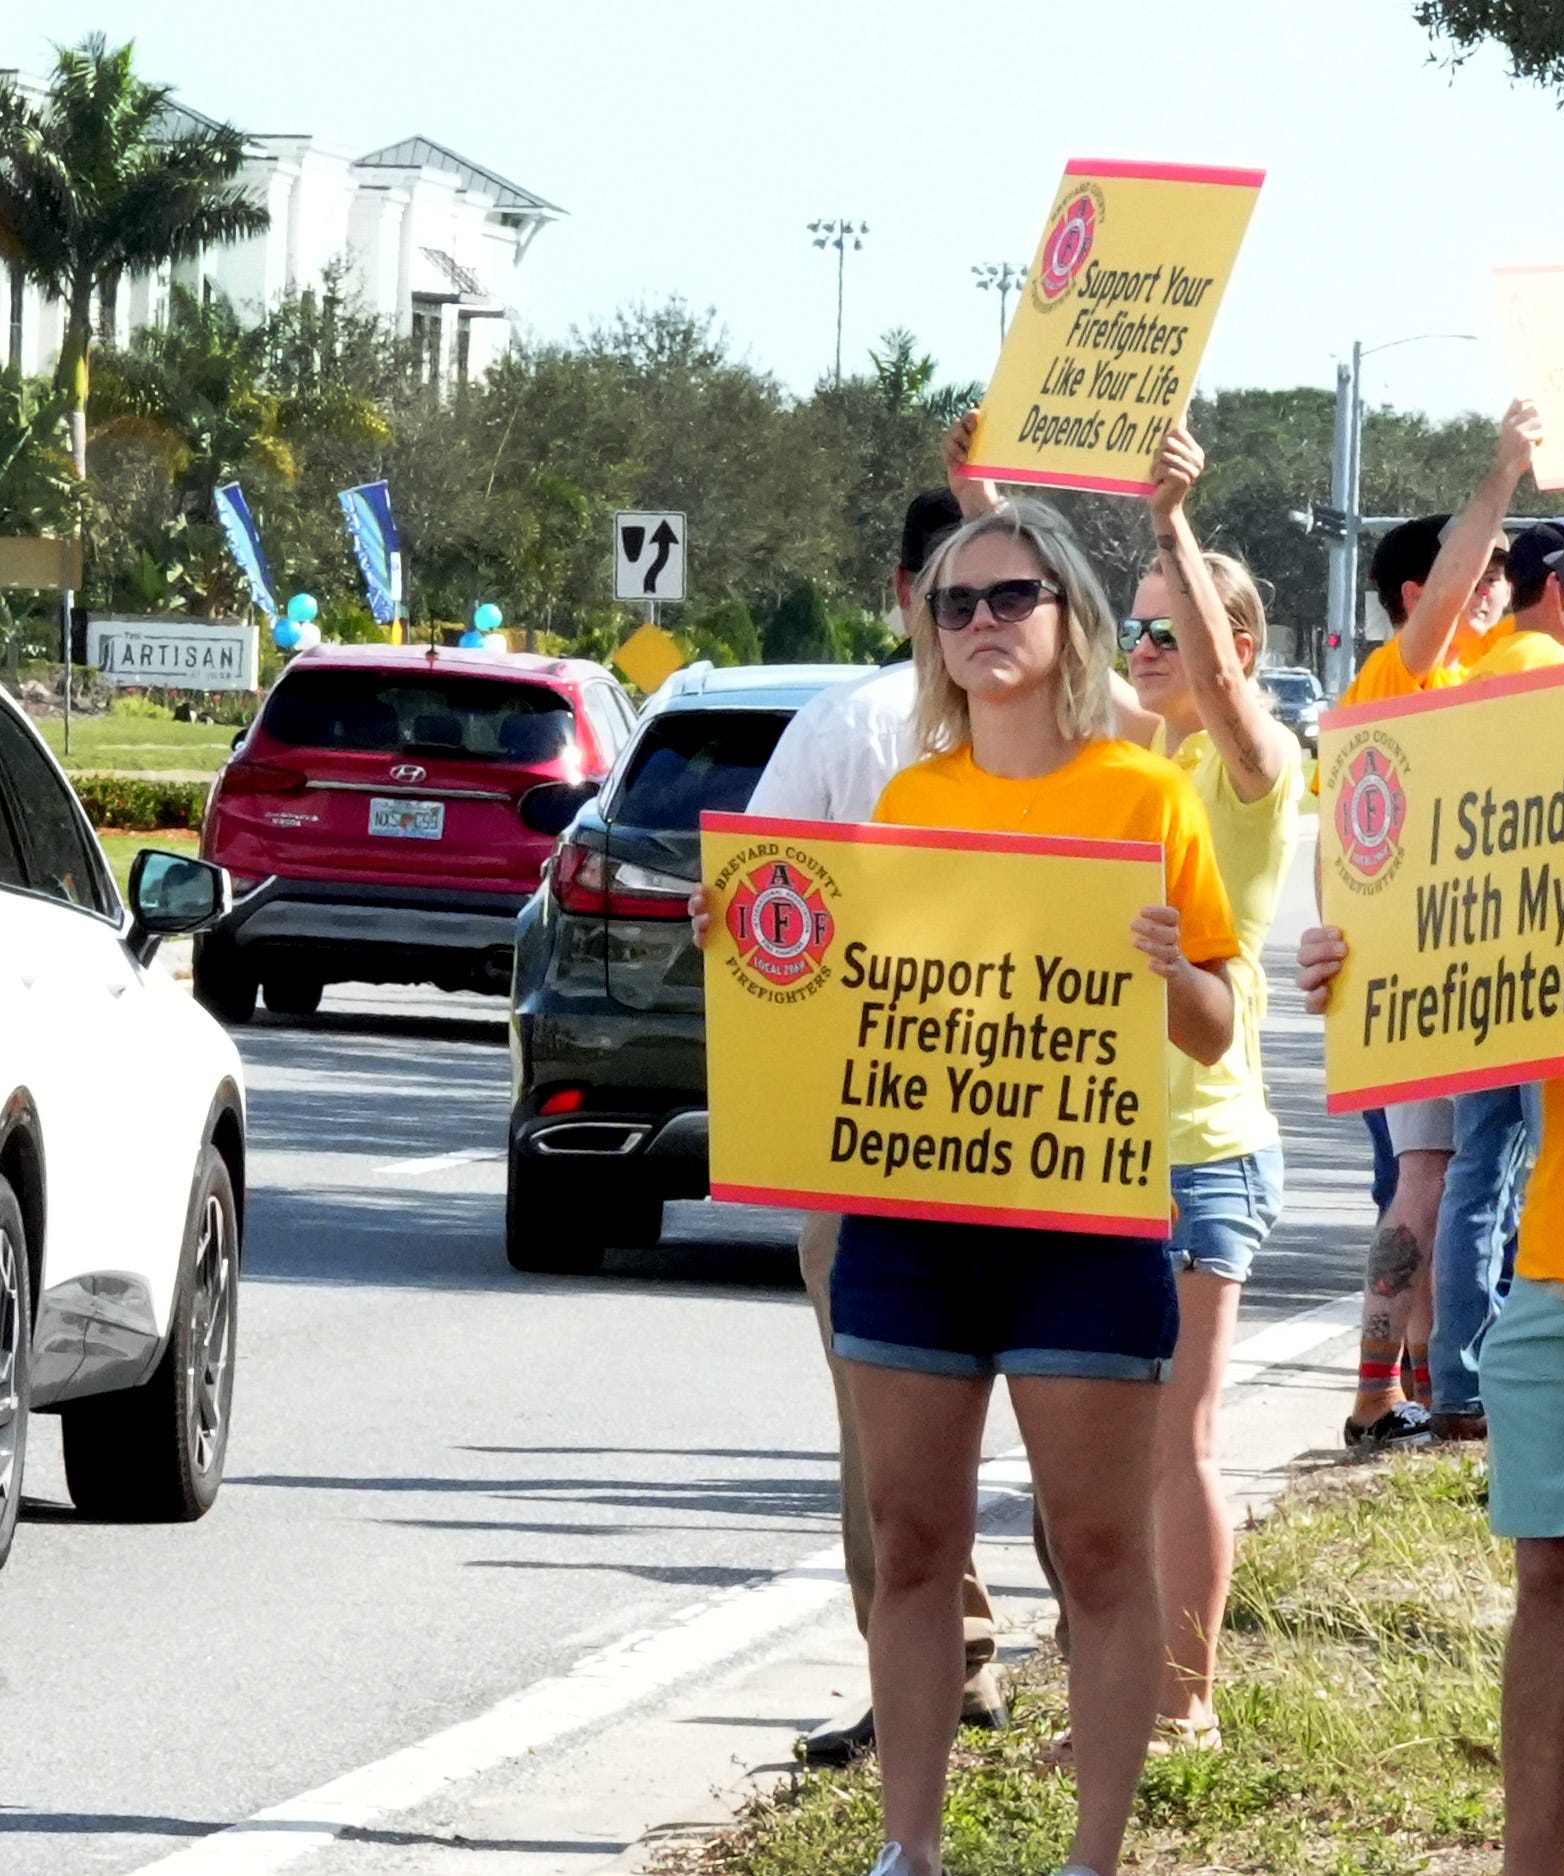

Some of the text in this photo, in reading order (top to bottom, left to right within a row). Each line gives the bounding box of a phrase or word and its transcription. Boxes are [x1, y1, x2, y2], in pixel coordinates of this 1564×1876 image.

[1078, 260, 1161, 311] Support
[1163, 266, 1214, 307] Your
[1066, 308, 1188, 360] Firefighters
[1041, 356, 1180, 407] Like Your Life
[1018, 404, 1105, 453] Depends
[1106, 412, 1138, 451] On
[122, 644, 233, 669] ARTISAN
[1430, 798, 1442, 865] I
[715, 843, 843, 899] BREVARD COUNTY
[769, 864, 793, 887] A
[771, 902, 793, 945] F
[813, 912, 829, 945] F
[1416, 872, 1502, 953] With
[725, 956, 832, 1004] FIREFIGHTERS
[841, 941, 1132, 1007] Support Your
[858, 1002, 1117, 1067] Firefighters
[841, 1058, 1139, 1126] Like Your Life
[831, 1117, 1152, 1186] Depends On It!
